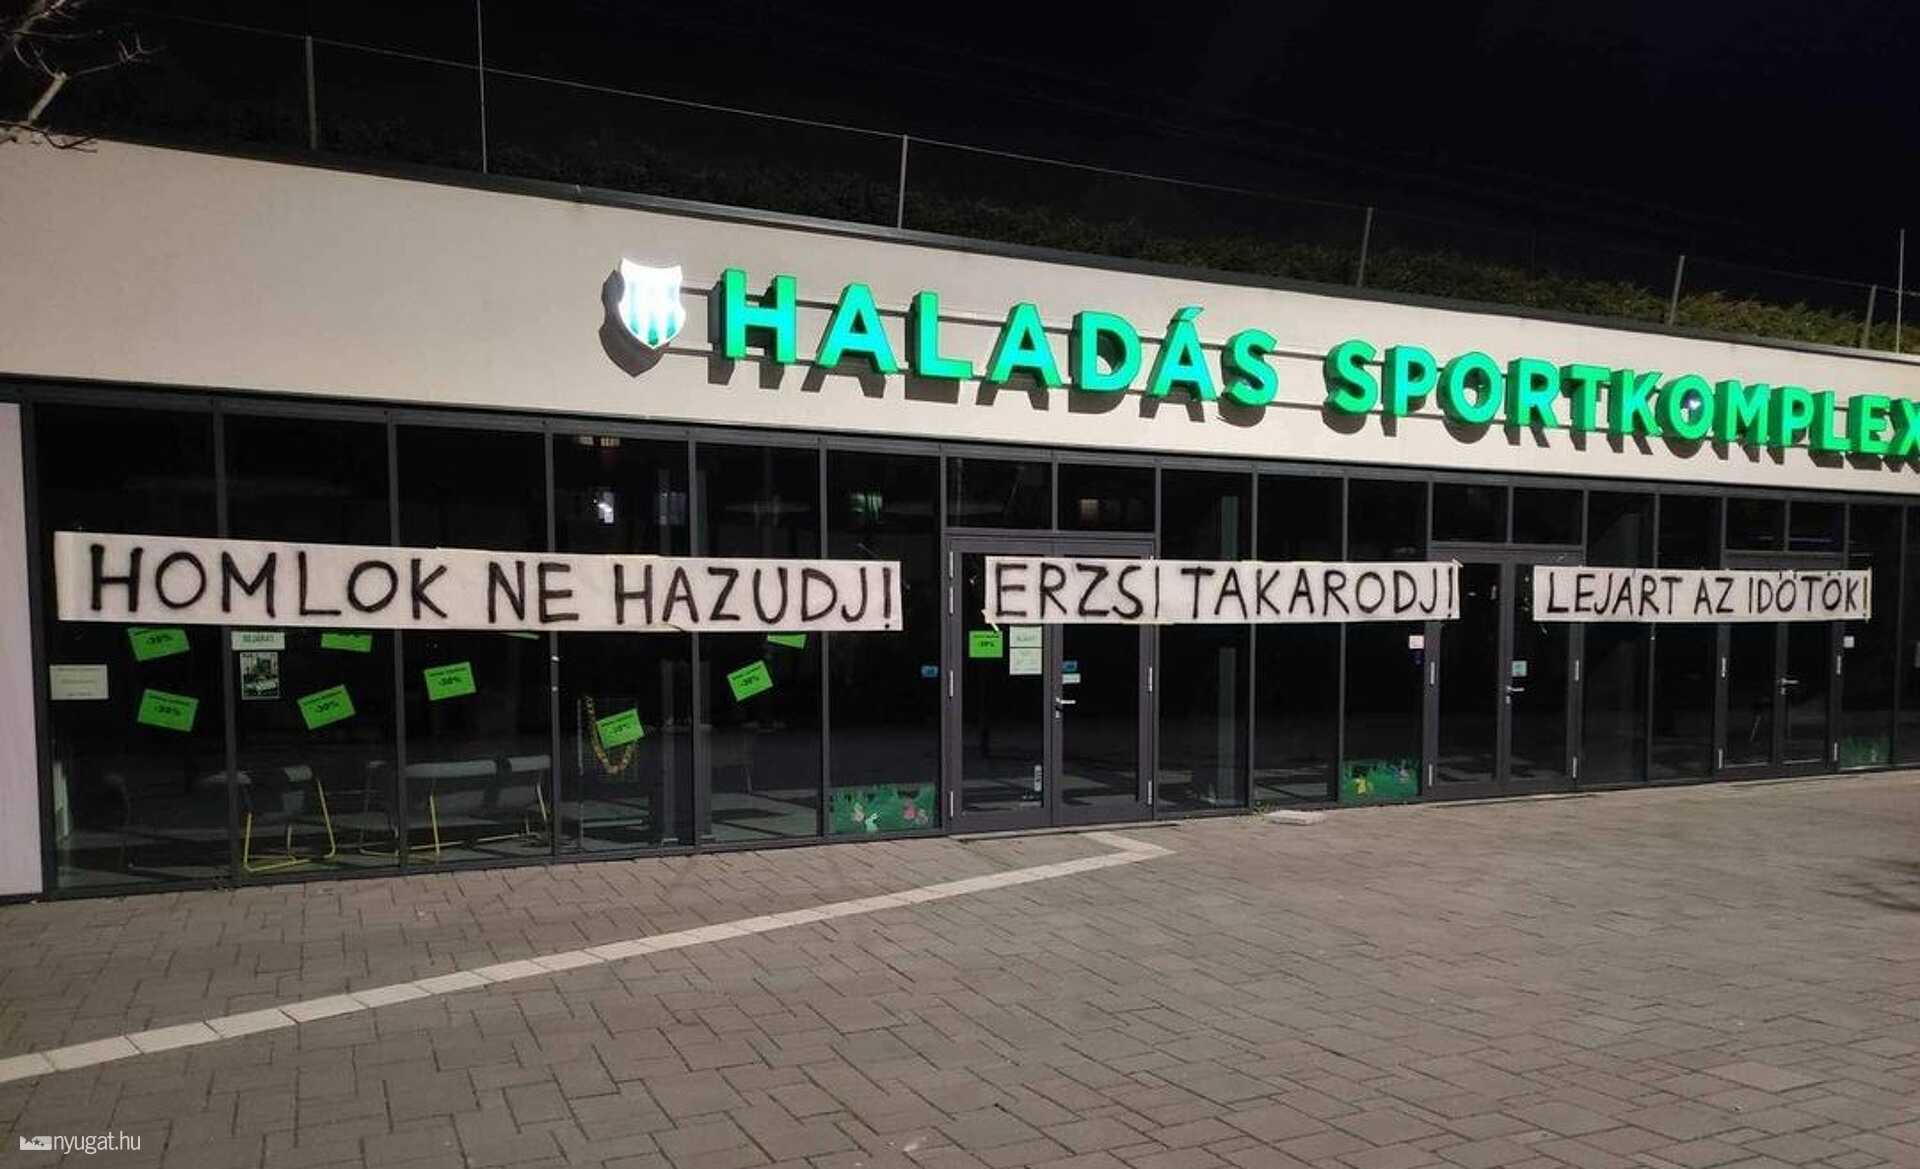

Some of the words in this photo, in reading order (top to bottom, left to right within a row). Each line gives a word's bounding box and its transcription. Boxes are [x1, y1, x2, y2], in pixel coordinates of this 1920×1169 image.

[718, 268, 1279, 405] HALADÁS
[1324, 339, 1920, 455] SPORTKOMPLEX
[90, 543, 448, 619] HOMLOK
[487, 560, 579, 625] NE
[613, 564, 893, 629] HAZUDJ!
[995, 562, 1160, 620] ERZSI
[1181, 566, 1453, 619] TAKARODJ!
[1694, 576, 1735, 614] AZ
